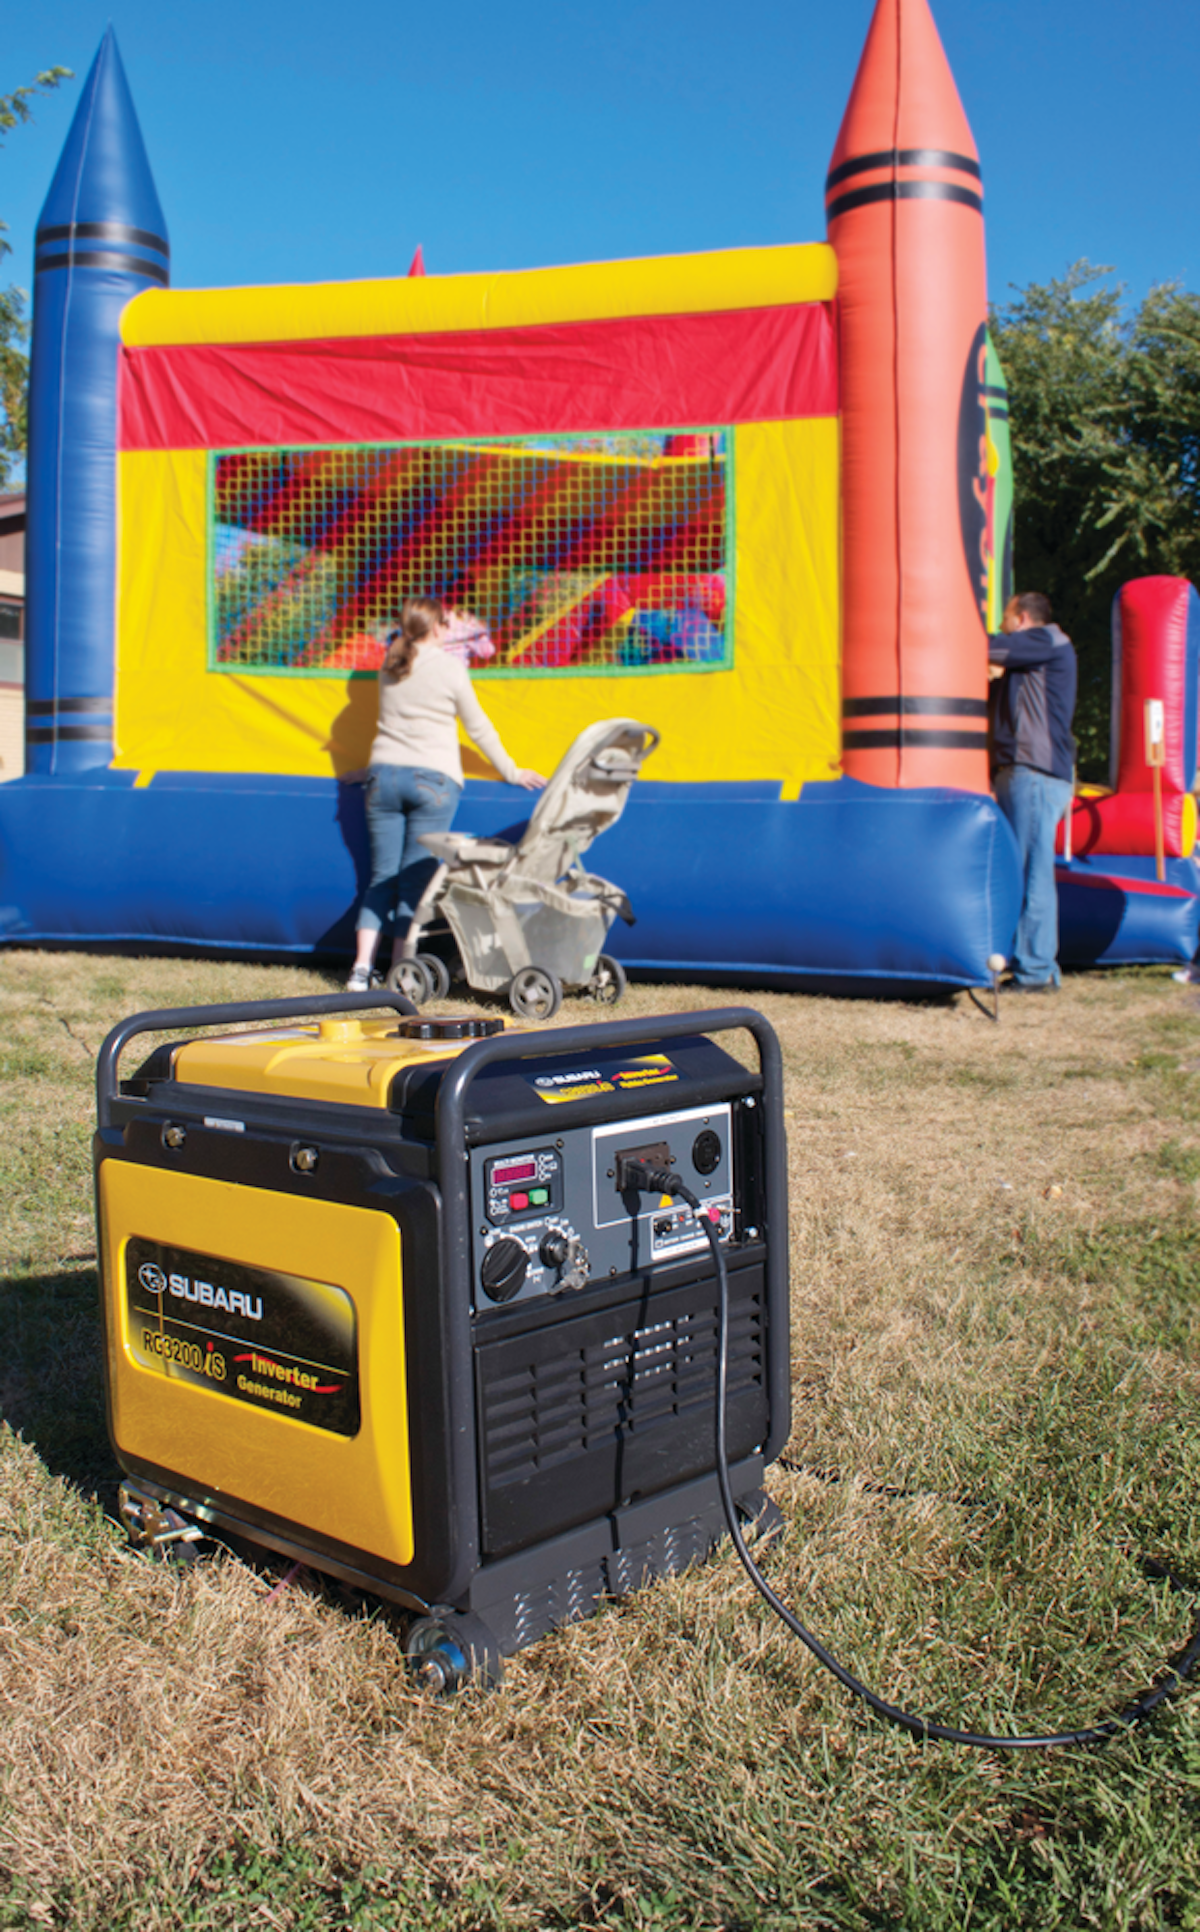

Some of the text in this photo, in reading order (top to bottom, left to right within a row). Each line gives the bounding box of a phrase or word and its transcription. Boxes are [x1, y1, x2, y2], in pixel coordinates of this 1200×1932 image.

[168, 1273, 264, 1321] SUBARU
[251, 1352, 320, 1391] Inverter
[236, 1374, 302, 1409] Generator
